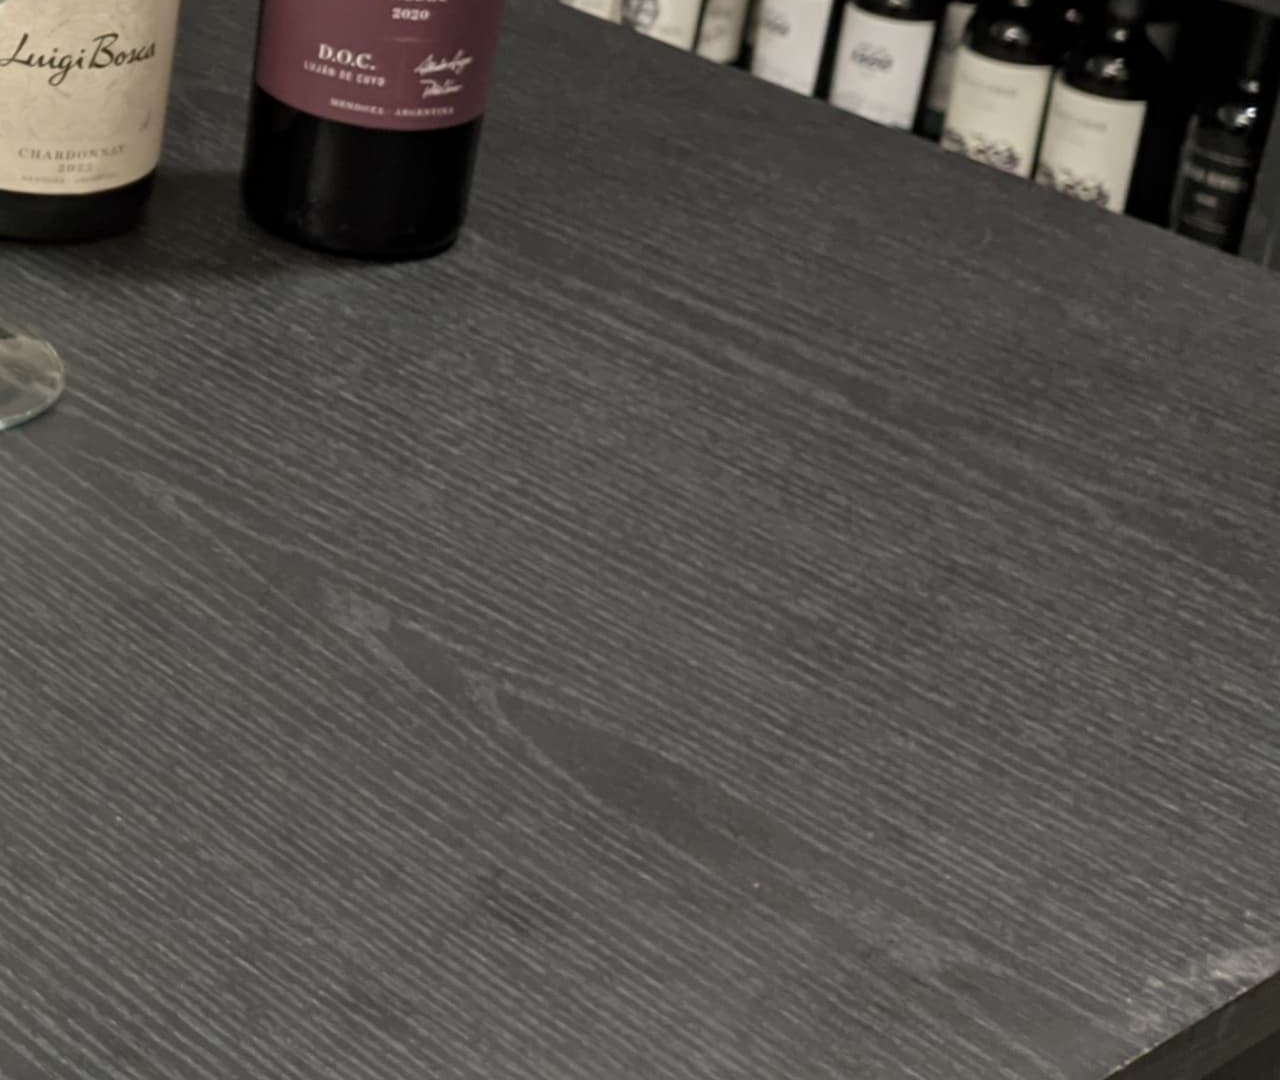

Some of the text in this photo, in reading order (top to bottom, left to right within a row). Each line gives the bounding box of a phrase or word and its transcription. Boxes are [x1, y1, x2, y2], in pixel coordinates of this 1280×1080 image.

[391, 7, 430, 21] 2020
[88, 32, 156, 70] Bosca
[318, 43, 376, 70] D.O.C.
[338, 69, 352, 82] DE
[18, 144, 126, 161] CHARDONNAY
